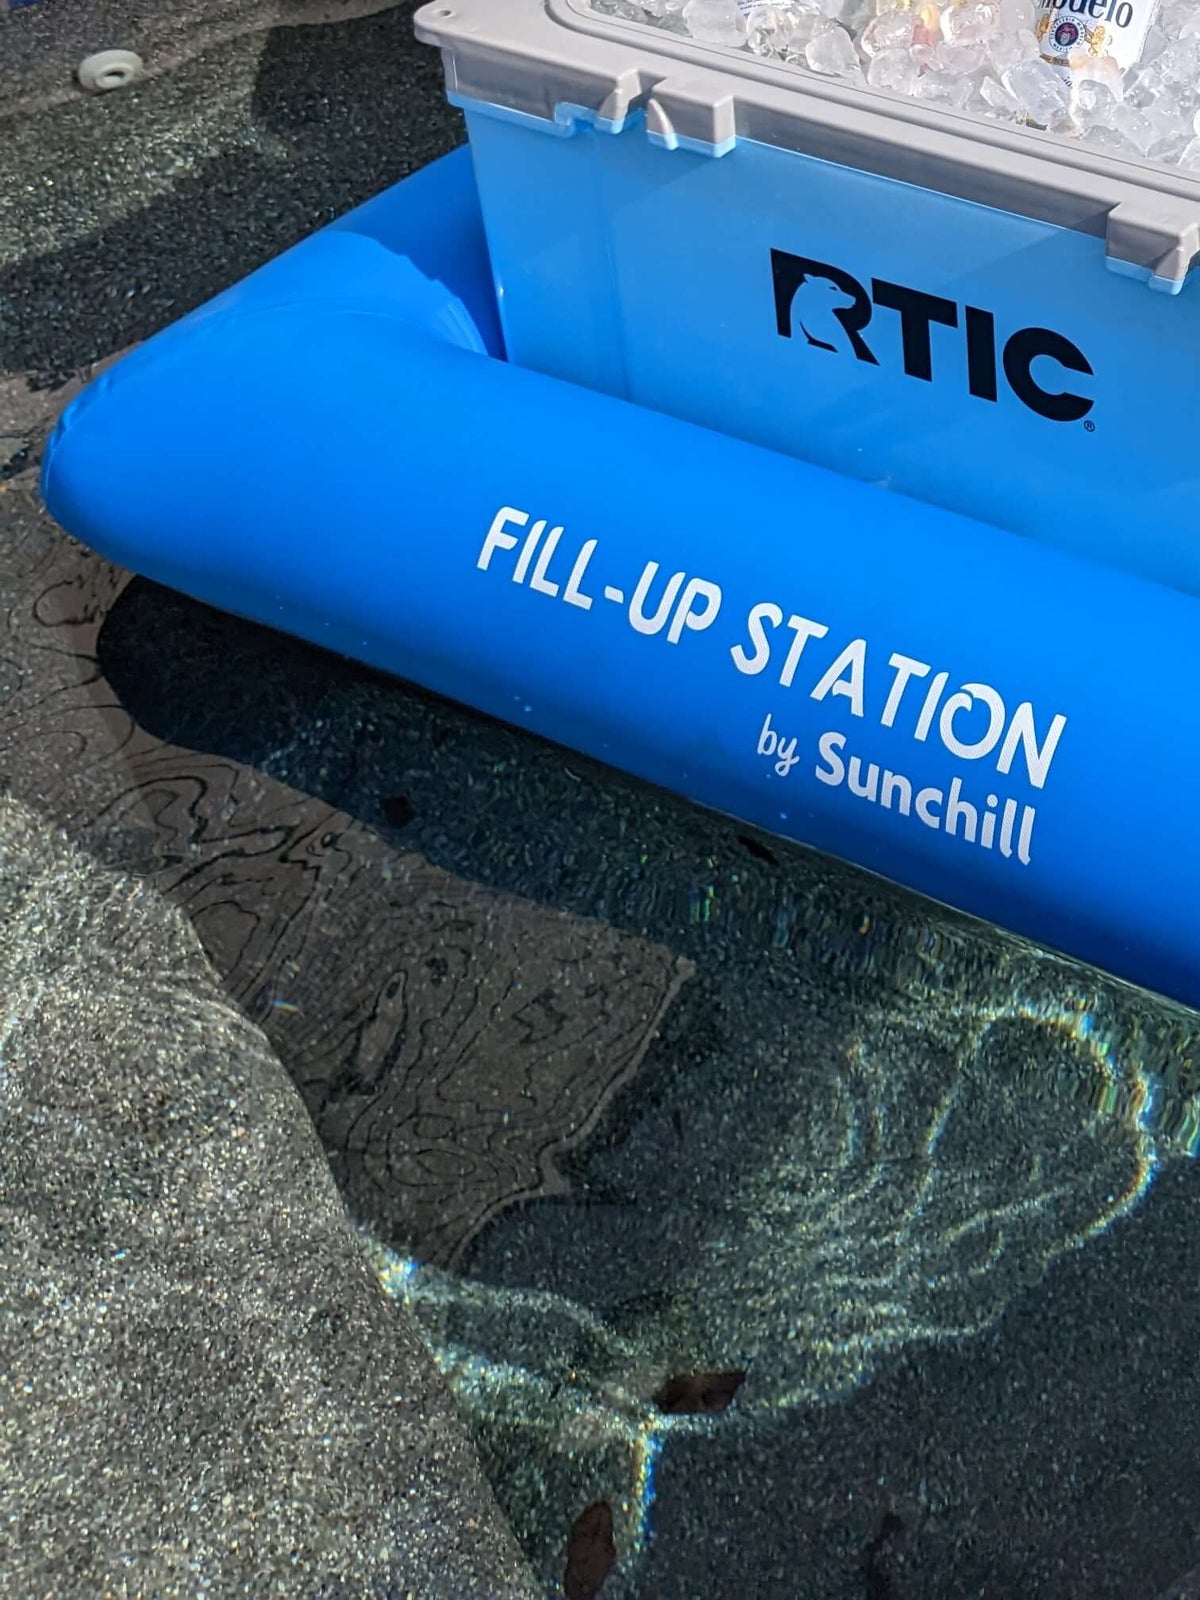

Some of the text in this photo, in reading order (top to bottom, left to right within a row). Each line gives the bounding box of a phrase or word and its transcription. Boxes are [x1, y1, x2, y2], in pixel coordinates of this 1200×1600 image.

[770, 247, 1095, 423] RTIC
[476, 506, 1068, 789] FILL-UP STATION
[757, 713, 1037, 866] by Sunchill
